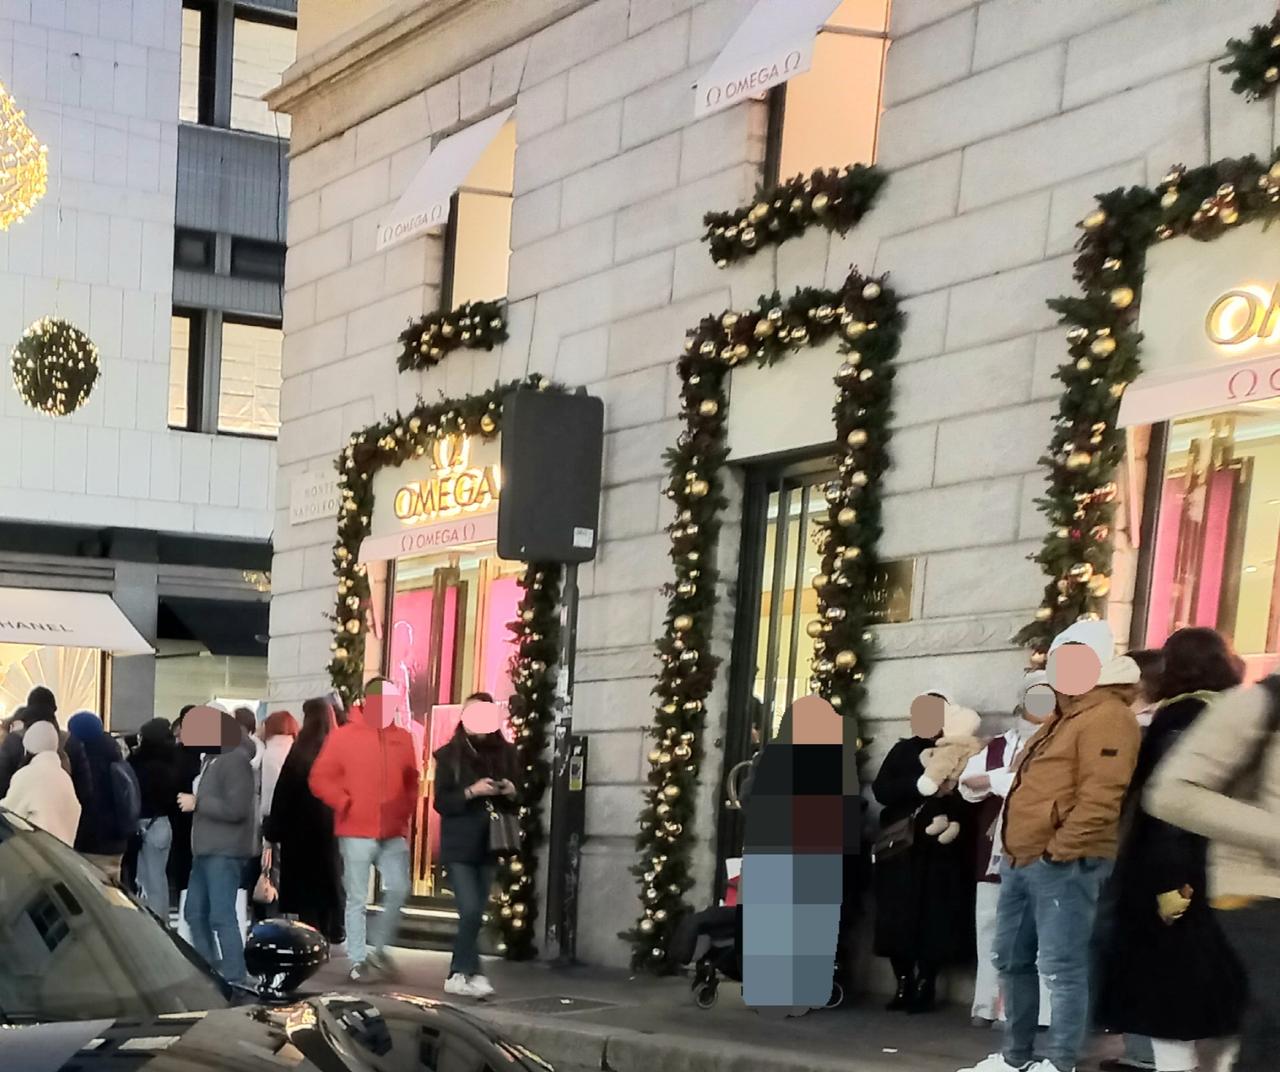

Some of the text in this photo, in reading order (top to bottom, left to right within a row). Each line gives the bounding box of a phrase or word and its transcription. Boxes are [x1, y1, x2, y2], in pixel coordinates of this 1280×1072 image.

[725, 64, 779, 99] OMEGA
[394, 212, 428, 237] OMEGA
[394, 466, 500, 520] OMEGA
[416, 529, 459, 547] OMEGA
